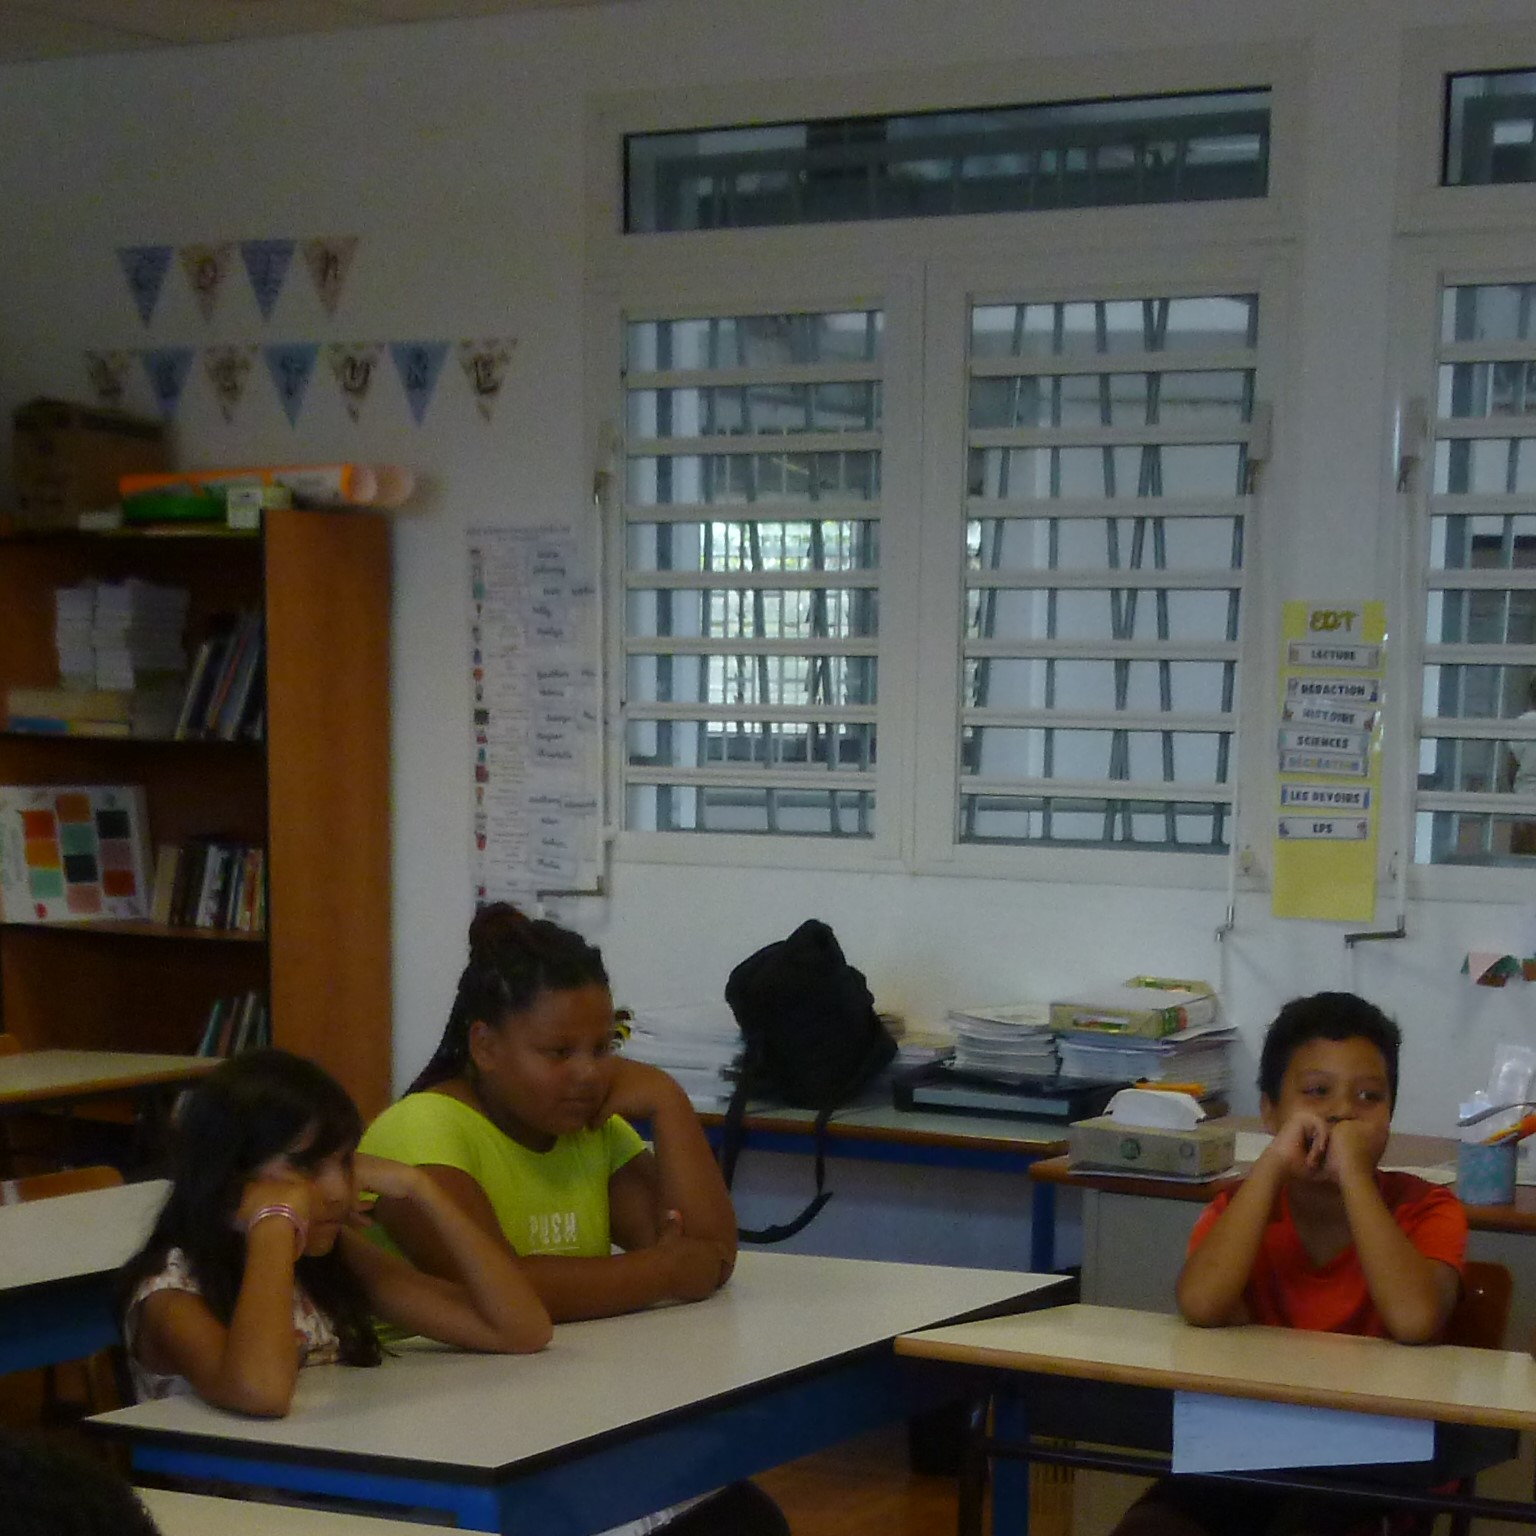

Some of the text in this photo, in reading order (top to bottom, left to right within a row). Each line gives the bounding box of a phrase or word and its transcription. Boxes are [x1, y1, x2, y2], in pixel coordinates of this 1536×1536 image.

[1310, 649, 1357, 661] LECTURE
[1302, 707, 1357, 725] HISTOIRE
[1296, 735, 1350, 749] SCIENCES
[1289, 790, 1361, 804] LES DEVOIRS
[1312, 822, 1334, 834] EPS
[529, 1212, 577, 1246] PUSH
